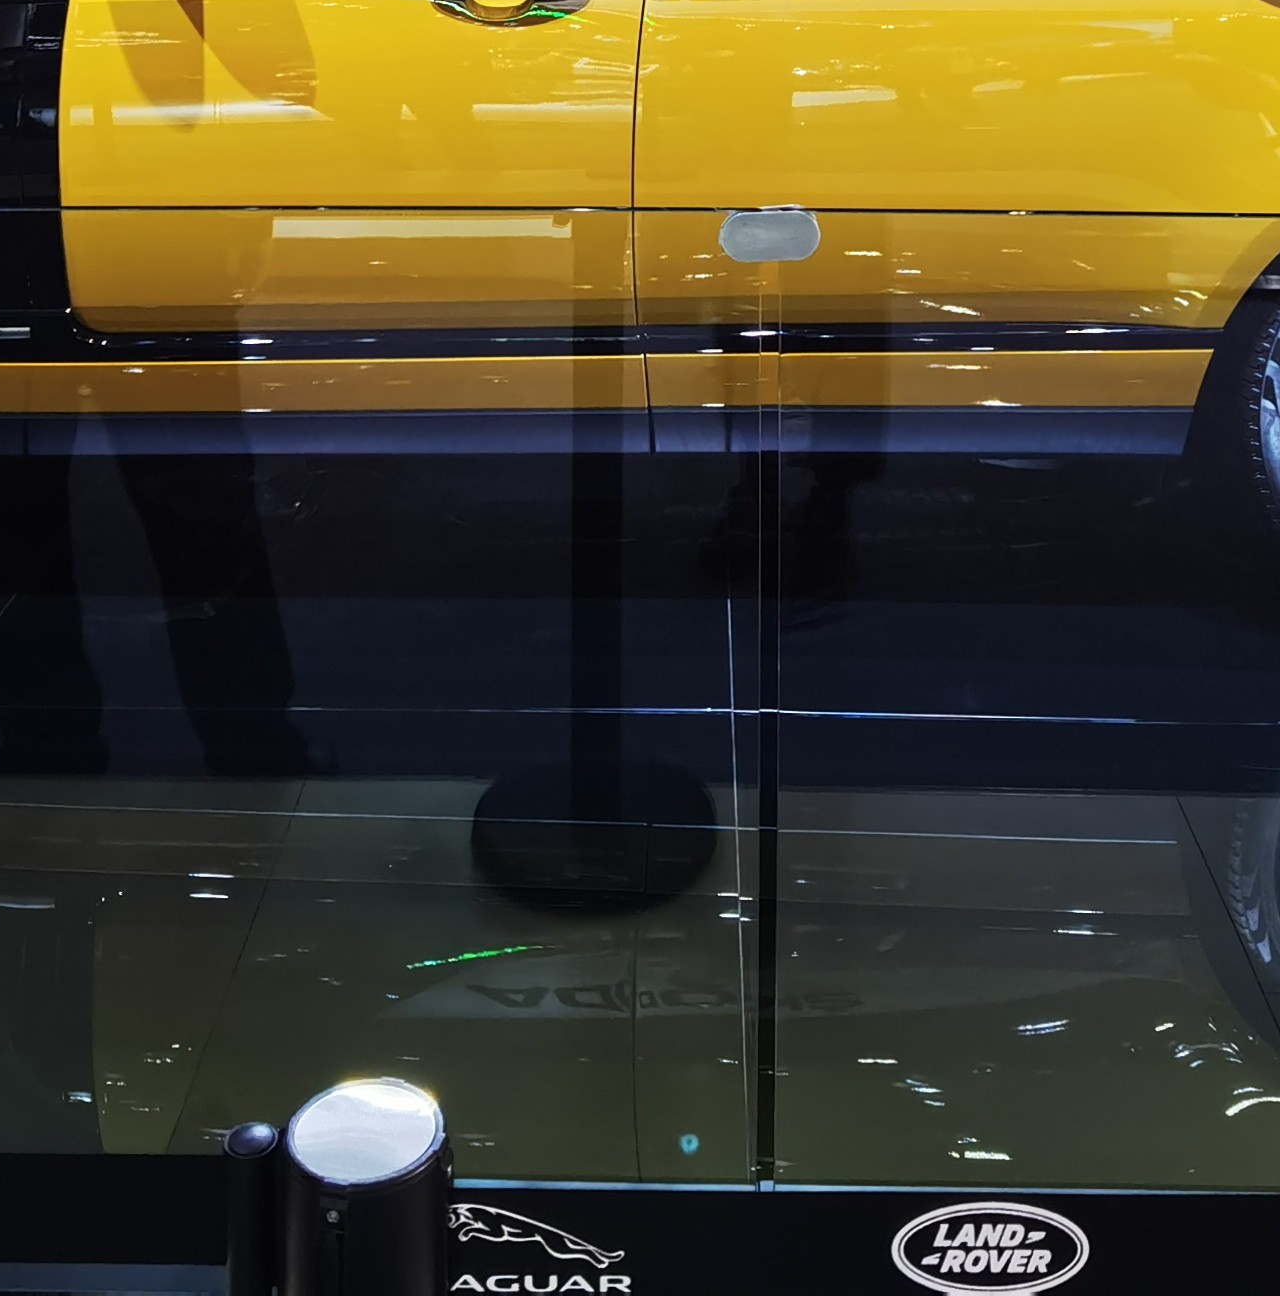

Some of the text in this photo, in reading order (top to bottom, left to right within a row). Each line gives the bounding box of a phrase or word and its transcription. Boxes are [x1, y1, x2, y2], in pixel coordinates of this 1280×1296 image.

[933, 1223, 1025, 1247] LAND
[940, 1249, 1052, 1273] ROVER
[450, 1274, 632, 1292] AGUAR
